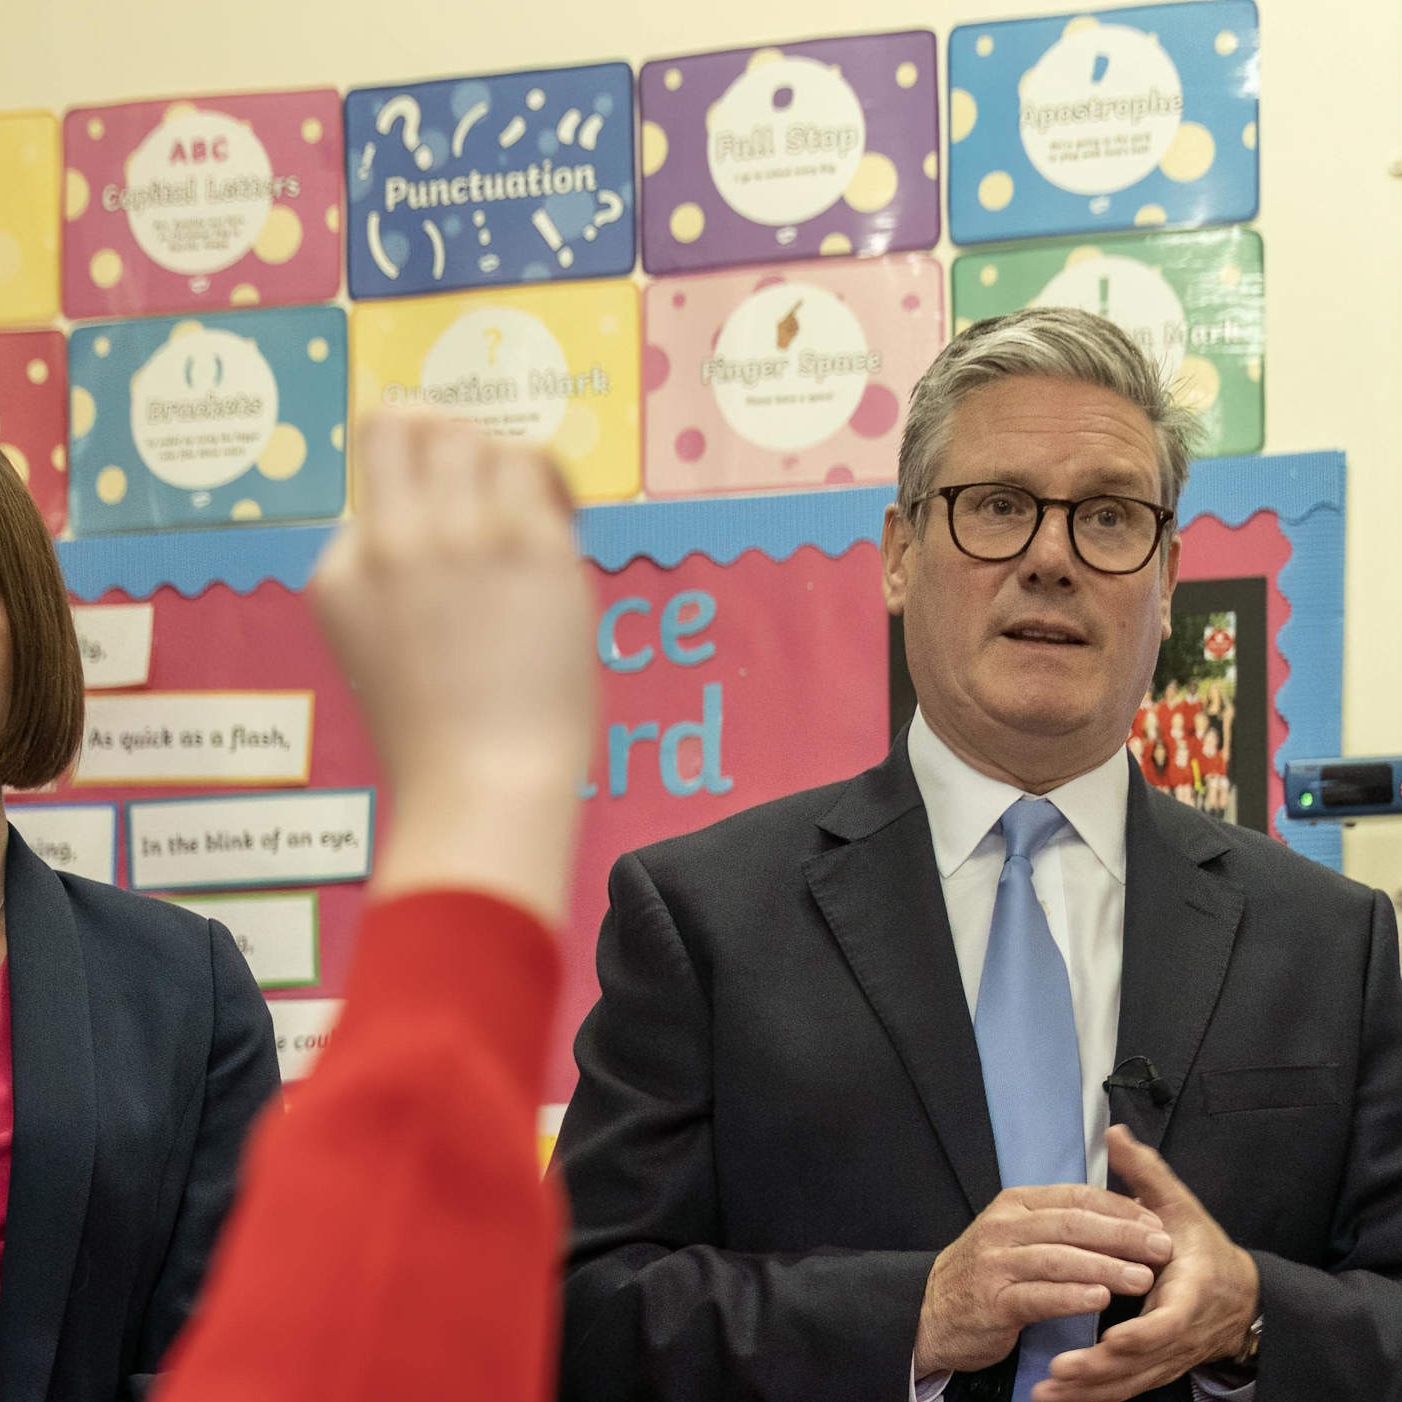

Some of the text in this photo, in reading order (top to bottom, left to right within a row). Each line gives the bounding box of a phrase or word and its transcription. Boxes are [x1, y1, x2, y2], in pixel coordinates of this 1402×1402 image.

[1021, 87, 1184, 133] Apostrophe
[715, 123, 858, 165] Full Stop
[102, 173, 301, 216] Capital Letters
[384, 160, 596, 212] Punctuation
[382, 364, 610, 407] Question Mark
[702, 349, 883, 388] Finger Space
[145, 392, 264, 424] Brackets
[89, 724, 291, 756] As quick as a flash,
[140, 826, 359, 858] In the blink of an eye,
